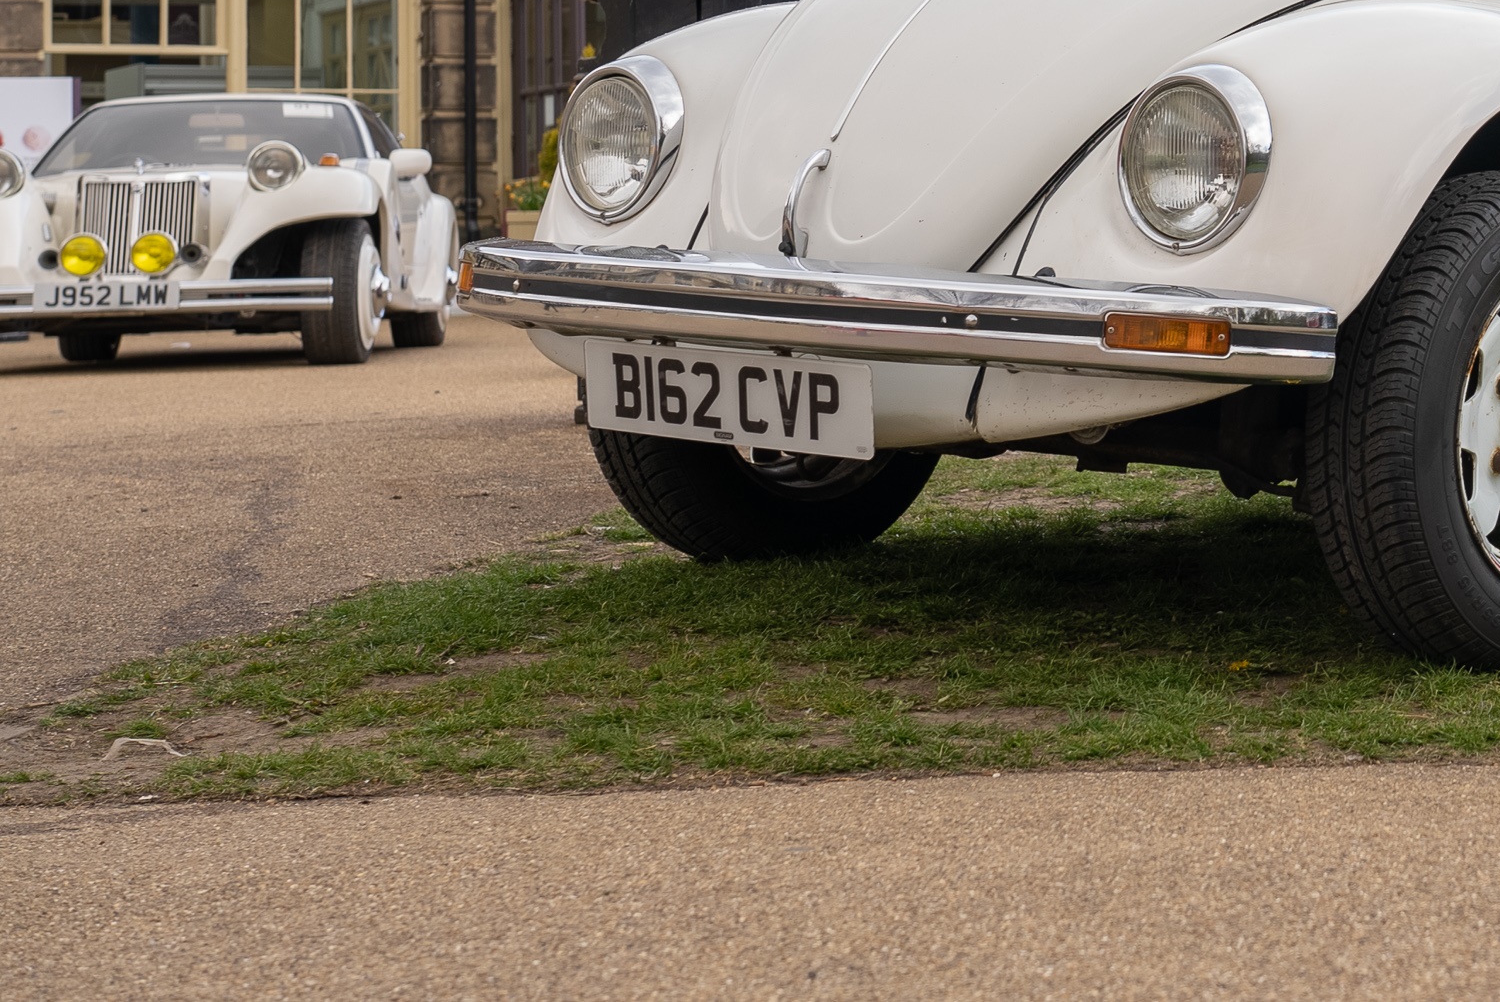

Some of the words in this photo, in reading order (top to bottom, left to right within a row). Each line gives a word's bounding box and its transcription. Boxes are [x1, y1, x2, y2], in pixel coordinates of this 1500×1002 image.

[45, 286, 111, 307] J952
[118, 284, 169, 307] LMW
[612, 352, 722, 430] B162
[738, 365, 840, 441] CVP
